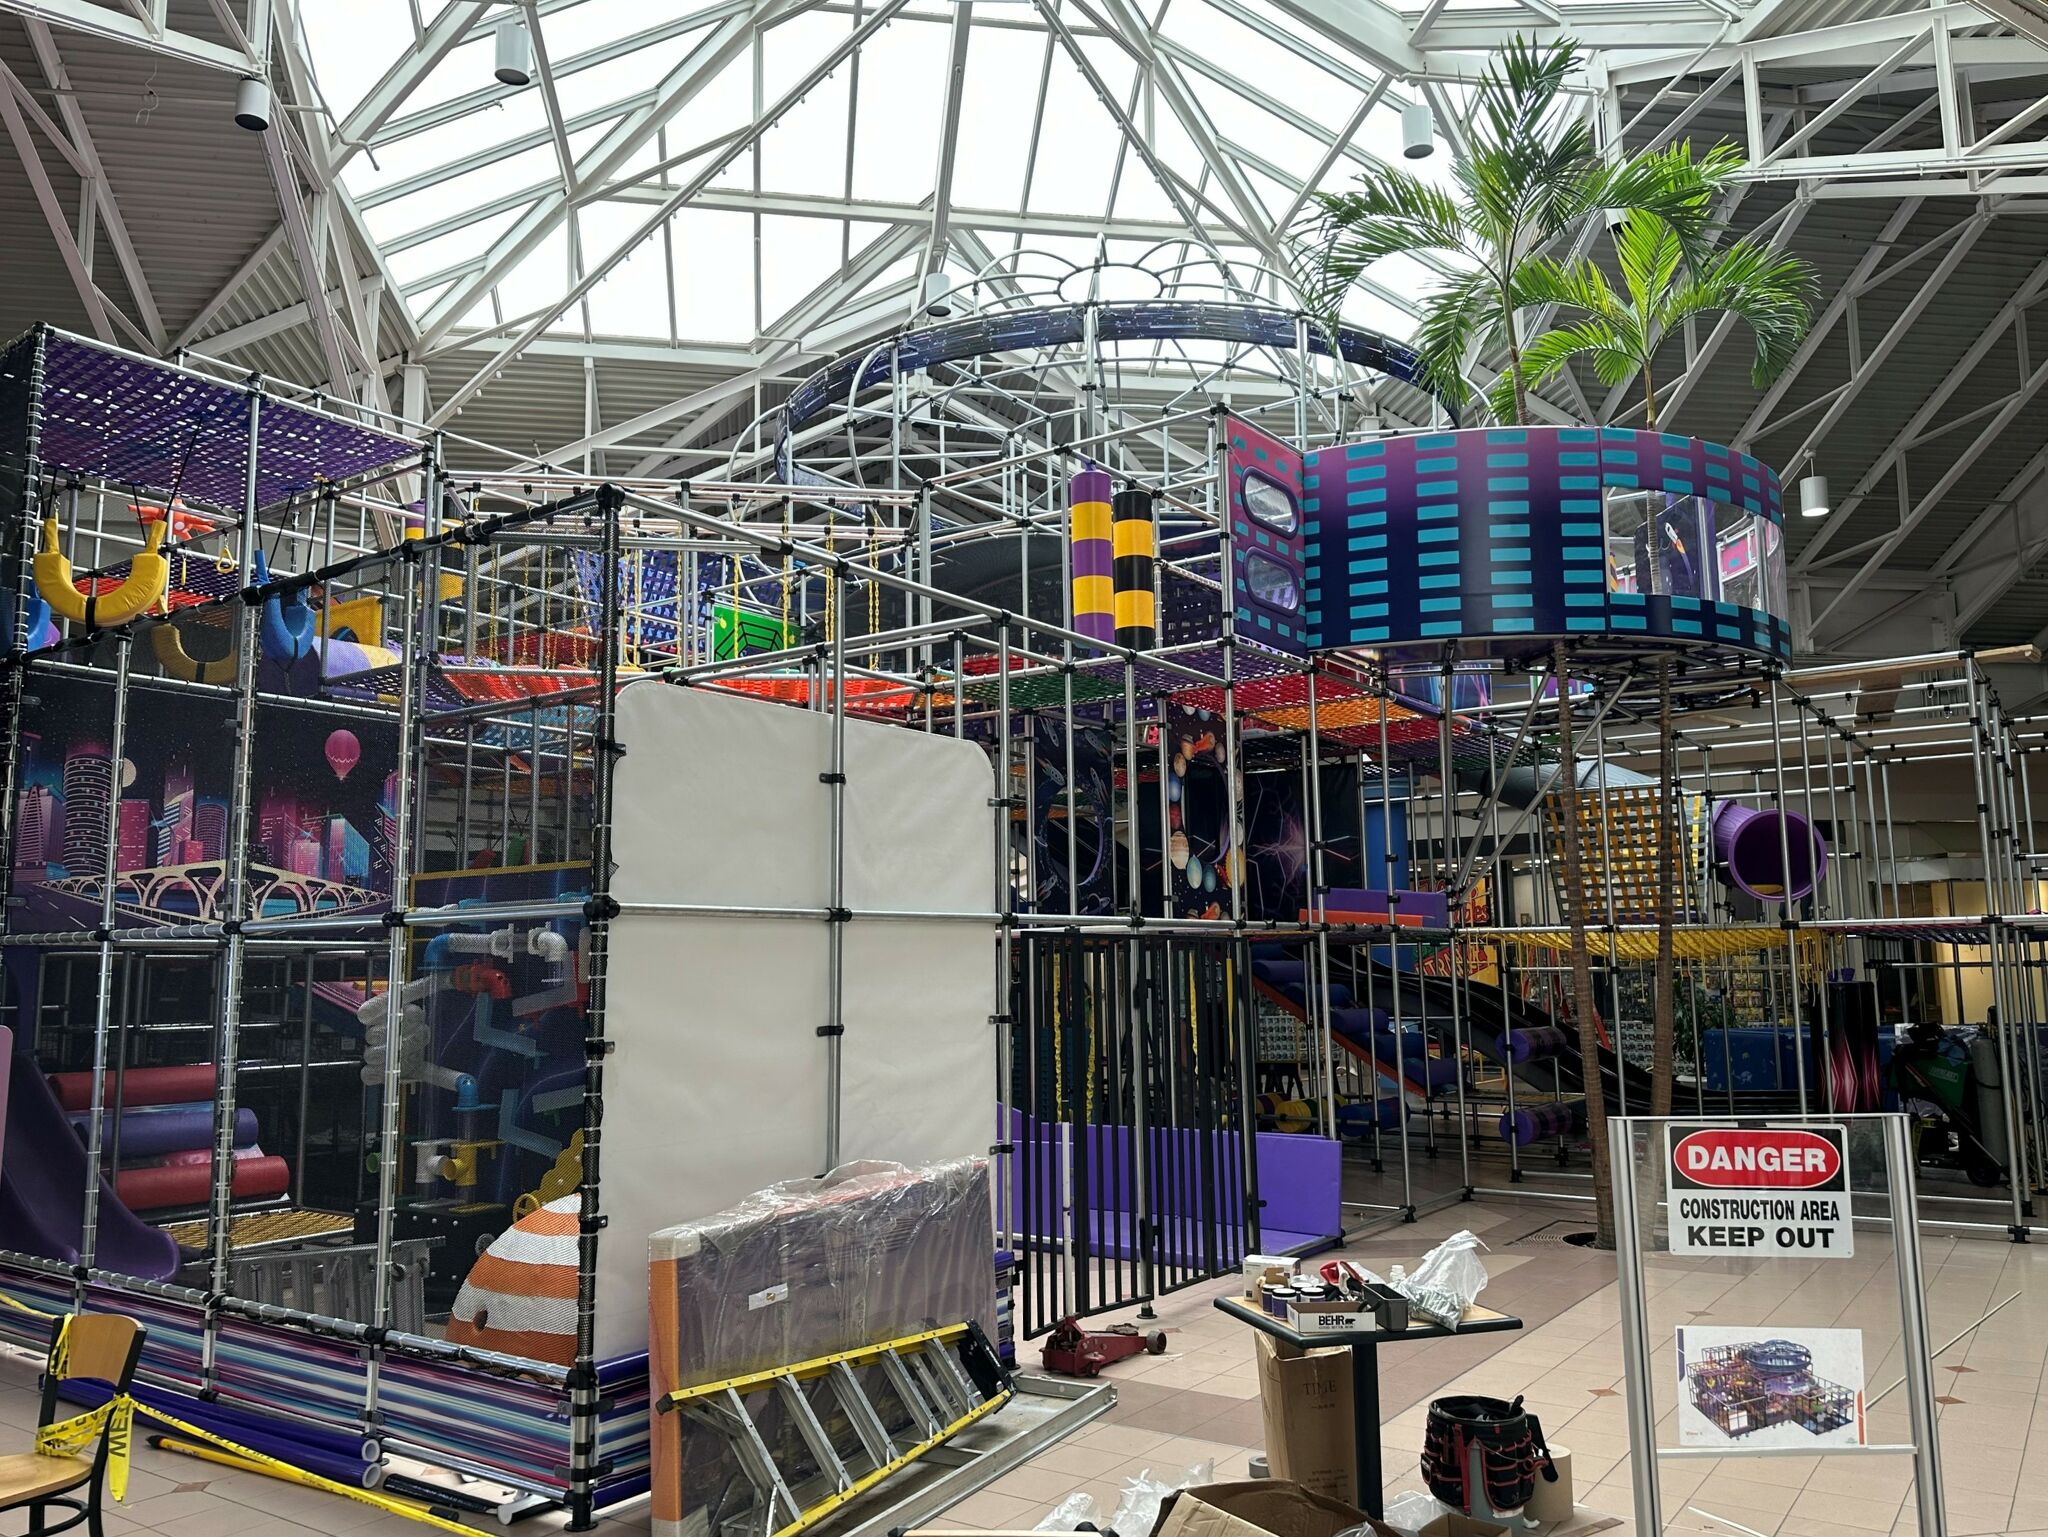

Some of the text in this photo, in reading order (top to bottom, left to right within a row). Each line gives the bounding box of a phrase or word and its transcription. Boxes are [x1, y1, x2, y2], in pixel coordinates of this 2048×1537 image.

[1687, 1145, 1827, 1172] DANGER
[1680, 1198, 1840, 1221] CONSTRUCTION AREA
[1688, 1226, 1835, 1248] KEEP OUT
[1318, 1315, 1345, 1326] BEHR
